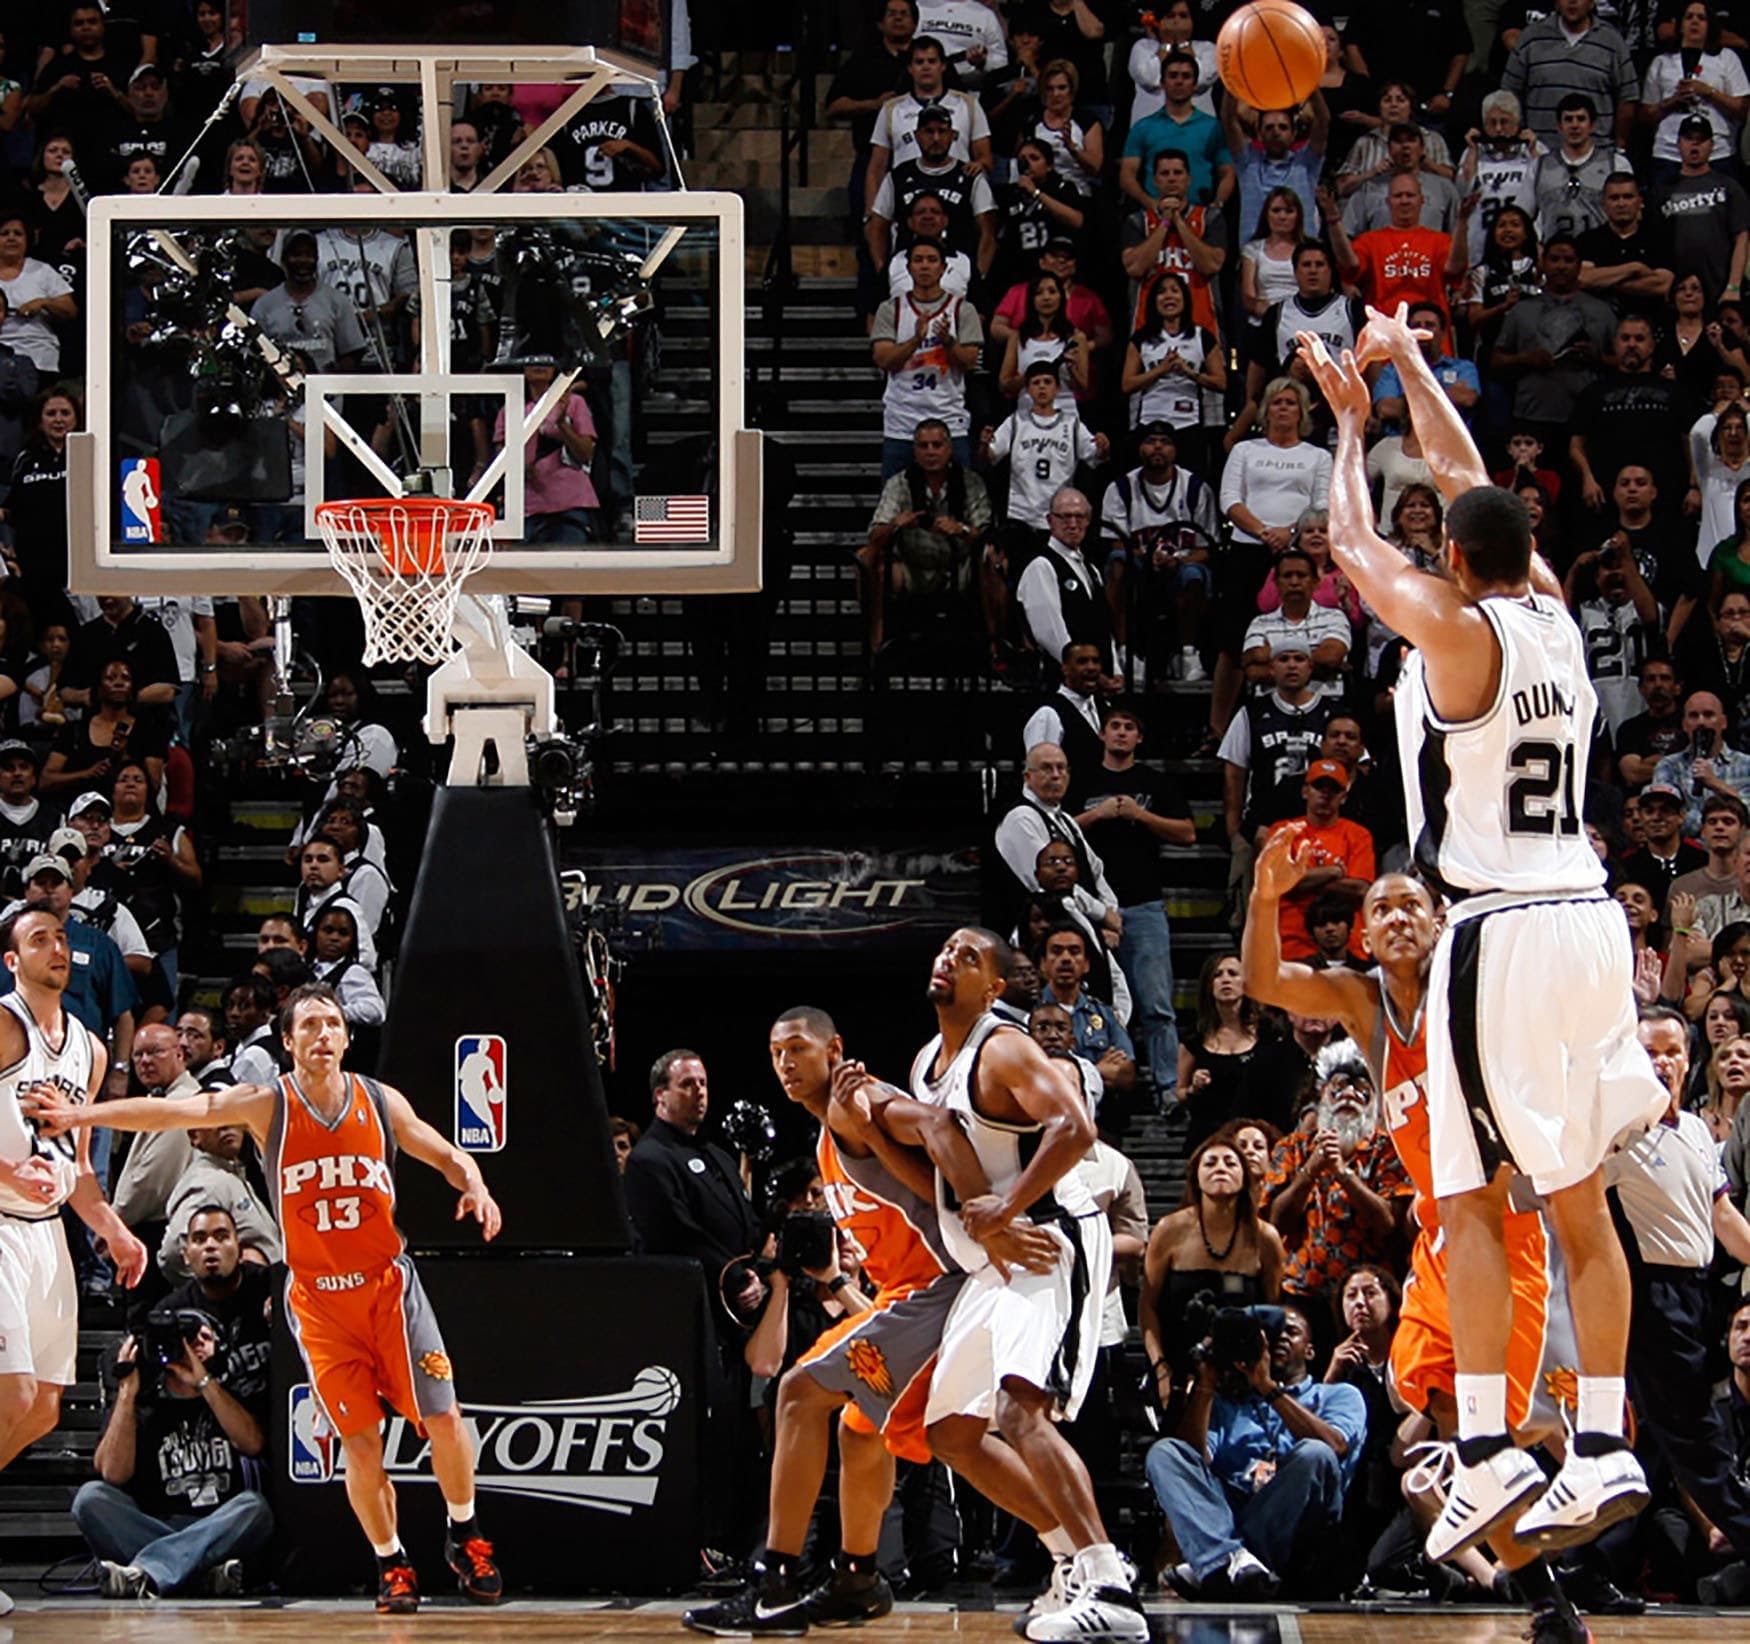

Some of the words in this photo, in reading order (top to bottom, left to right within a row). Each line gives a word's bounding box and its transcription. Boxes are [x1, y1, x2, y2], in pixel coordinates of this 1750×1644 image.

[571, 120, 627, 145] PARKER
[584, 145, 614, 186] 9
[912, 373, 938, 391] 34
[1035, 458, 1051, 480] 9
[1504, 738, 1580, 838] 21
[718, 880, 925, 911] LIGHT
[461, 1127, 490, 1144] NBA
[283, 1155, 390, 1195] PHX
[315, 1196, 361, 1232] 13
[315, 1271, 365, 1291] SUNS
[294, 1460, 320, 1476] NBA
